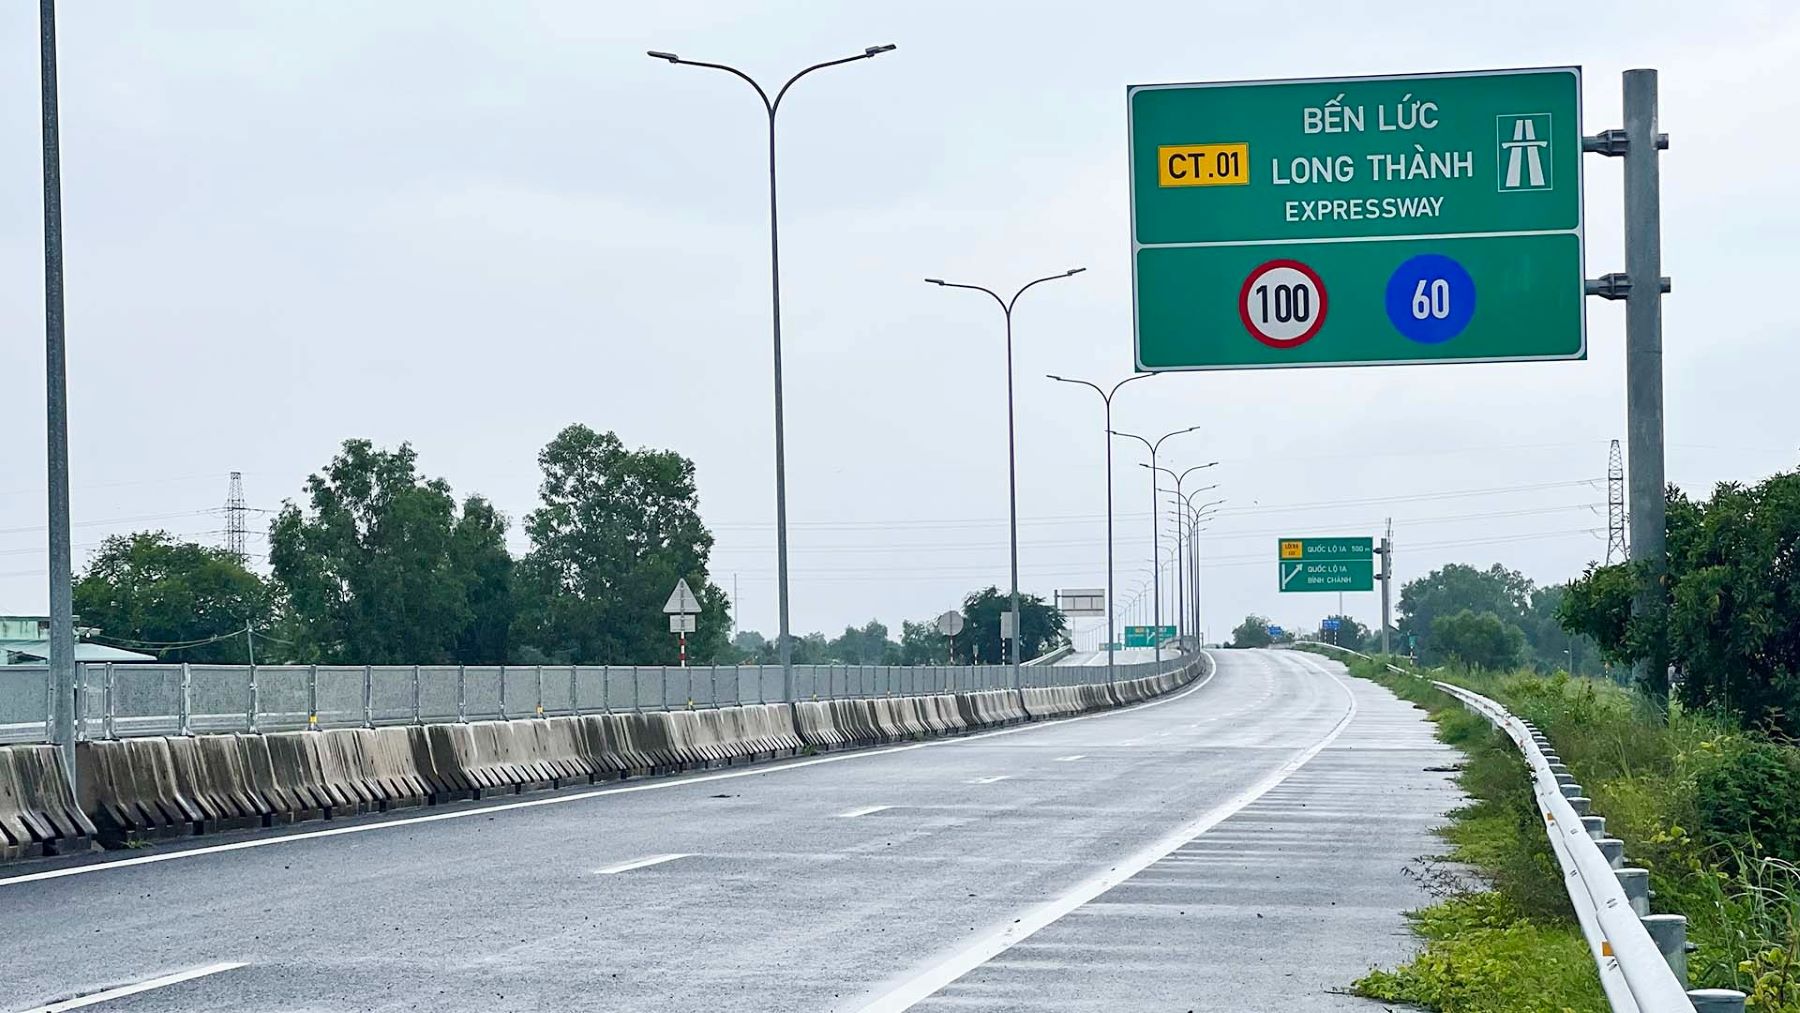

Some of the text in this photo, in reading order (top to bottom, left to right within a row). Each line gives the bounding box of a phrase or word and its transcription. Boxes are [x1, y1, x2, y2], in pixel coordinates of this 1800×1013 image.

[1303, 93, 1439, 134] BẾN LỨC
[1168, 152, 1240, 179] CT.01
[1272, 144, 1473, 185] LONG THÀNH
[1285, 196, 1444, 222] EXPRESSWAY
[1255, 284, 1310, 323] 100
[1412, 279, 1450, 319] 60
[1308, 544, 1326, 552] QUỐC
[1308, 564, 1326, 572] QUỐC
